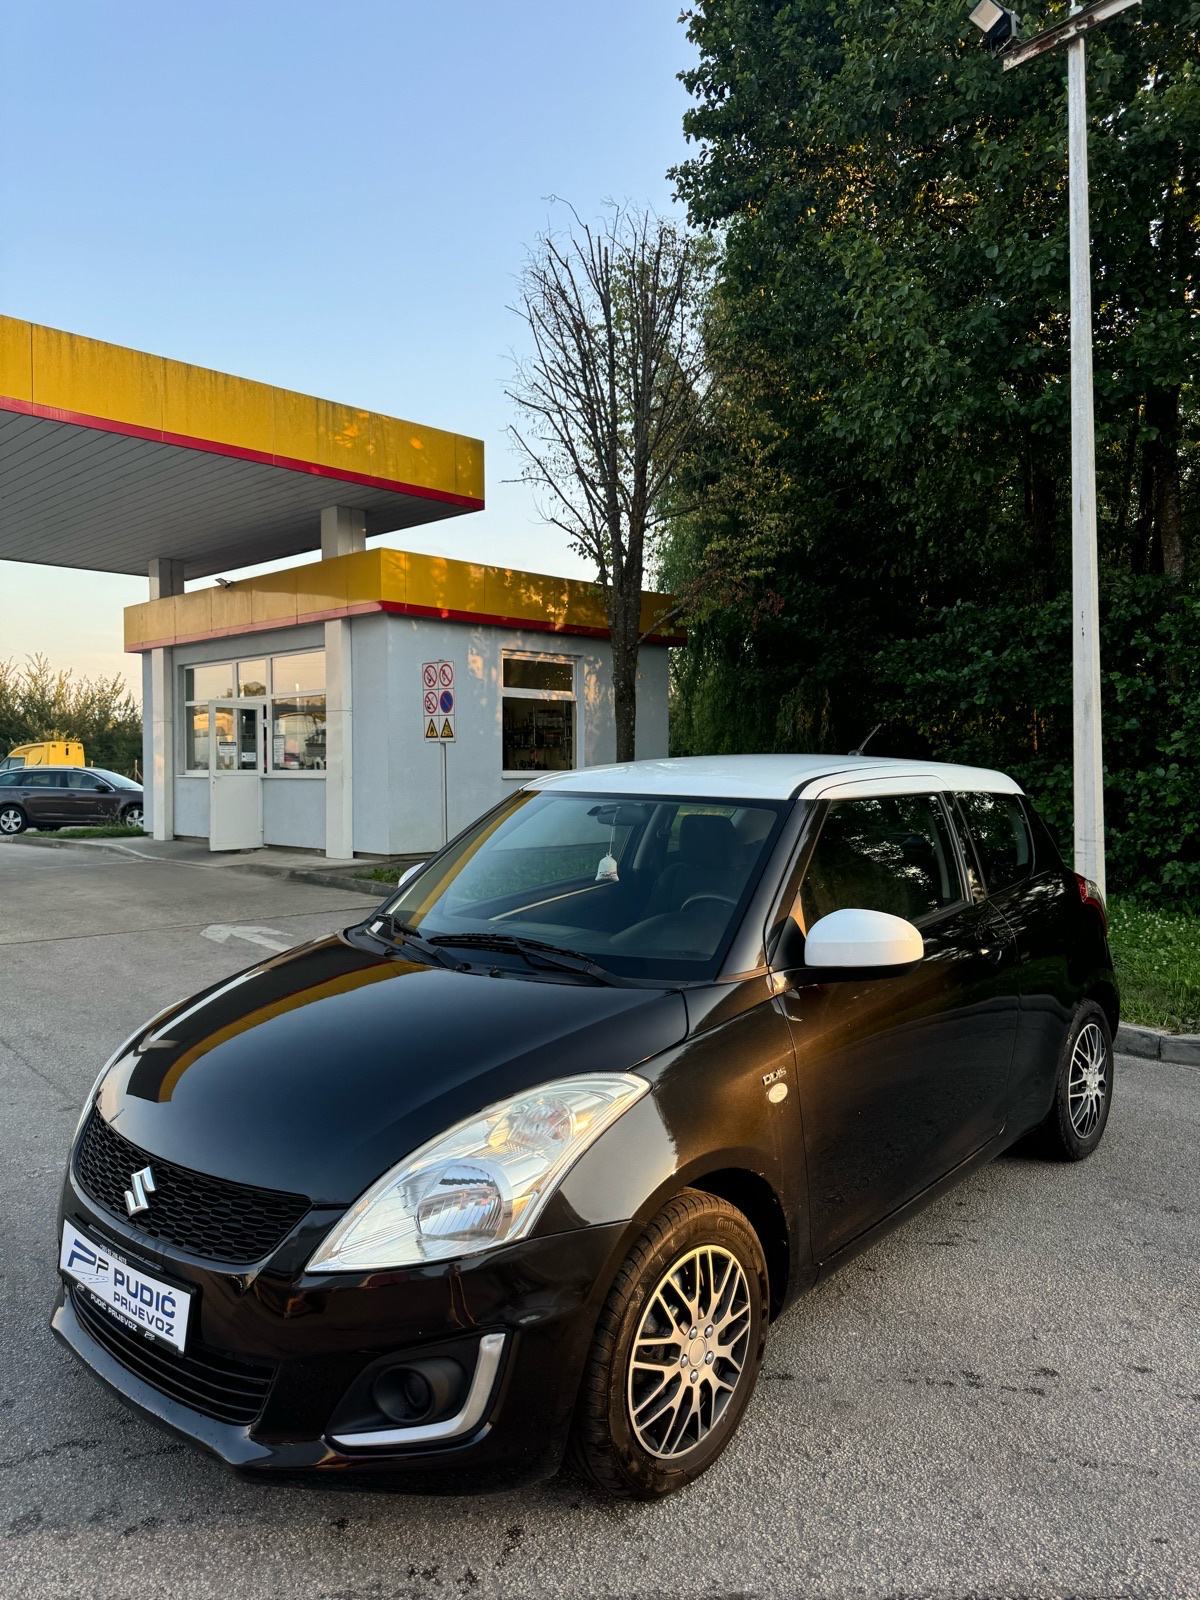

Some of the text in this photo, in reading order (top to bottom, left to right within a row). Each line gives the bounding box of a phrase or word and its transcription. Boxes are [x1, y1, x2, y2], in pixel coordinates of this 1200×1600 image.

[114, 1267, 176, 1319] PUDIĆ
[114, 1291, 175, 1337] PRIJEVOZ
[108, 1306, 138, 1332] PRIJEVOZ
